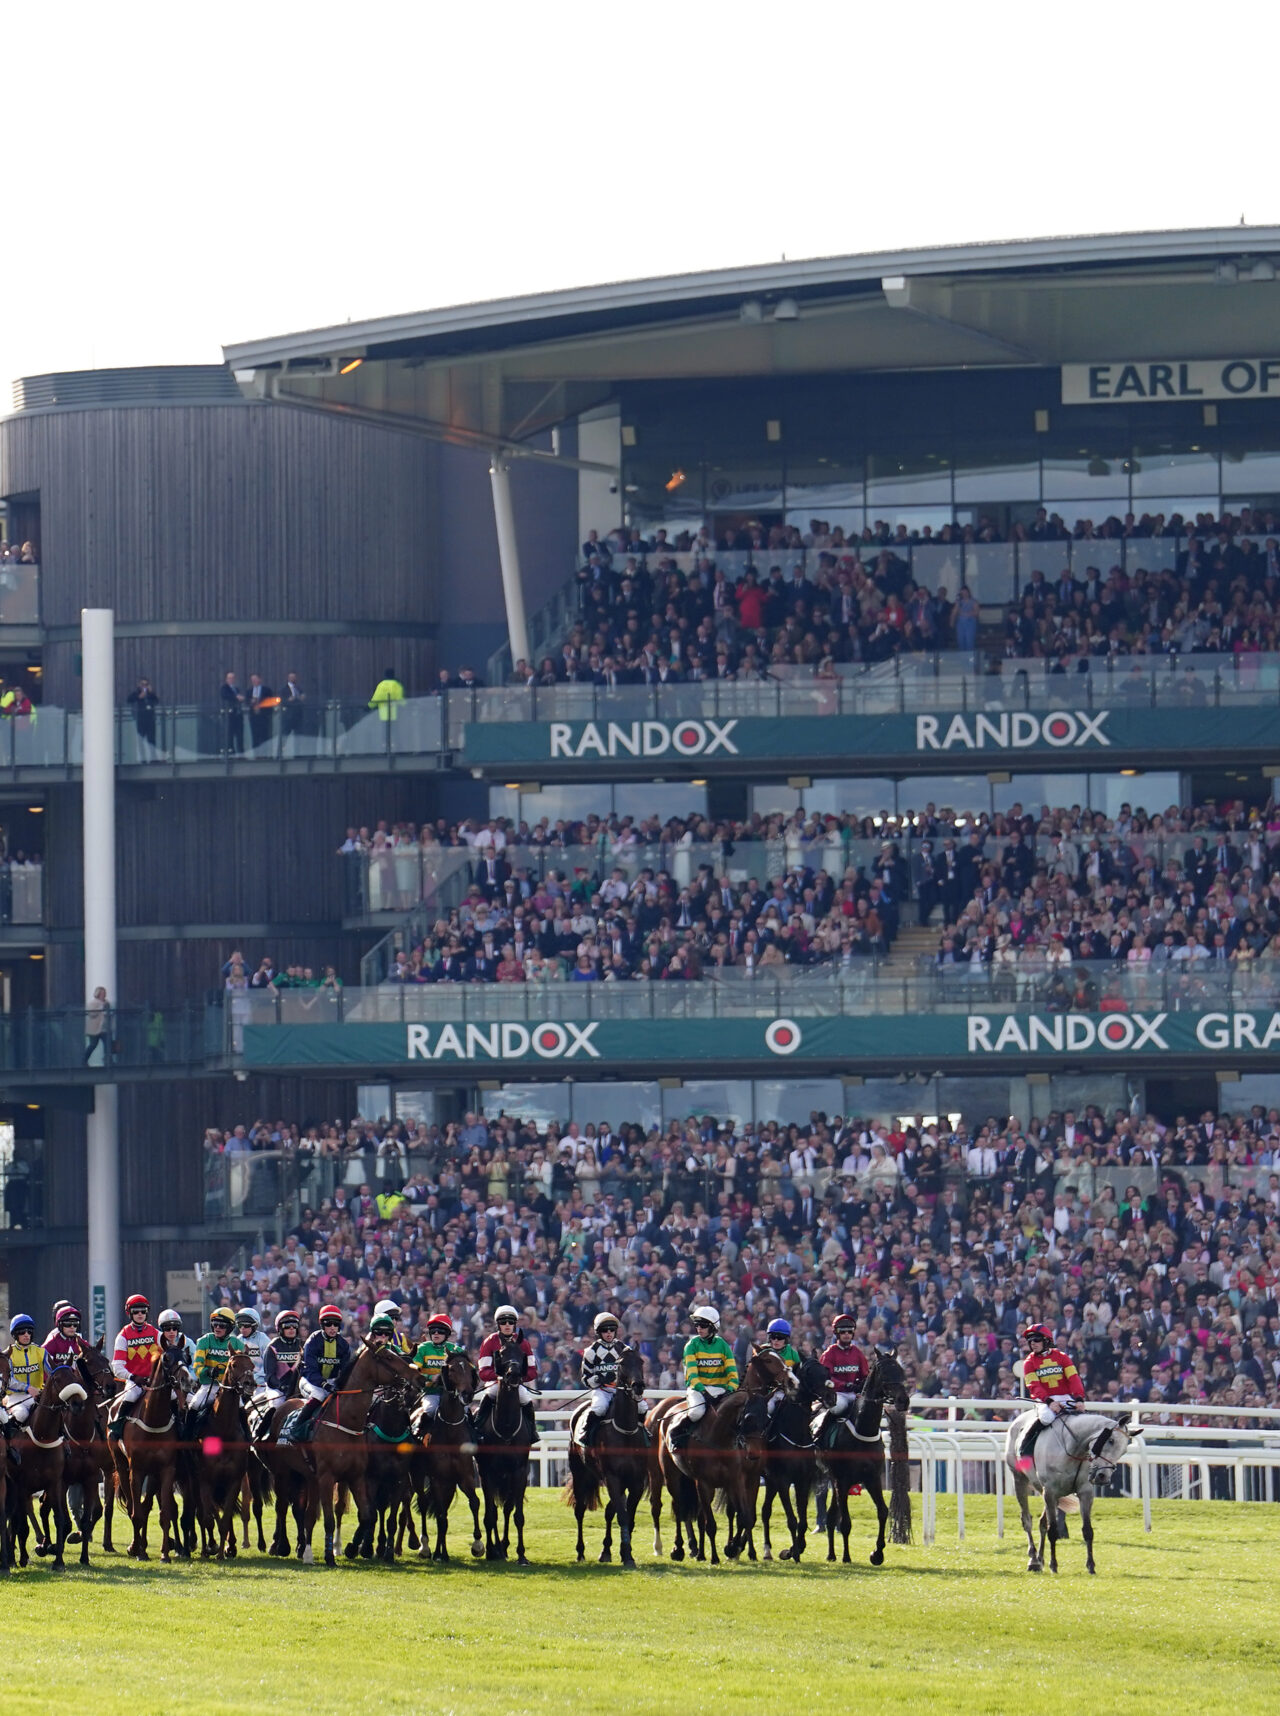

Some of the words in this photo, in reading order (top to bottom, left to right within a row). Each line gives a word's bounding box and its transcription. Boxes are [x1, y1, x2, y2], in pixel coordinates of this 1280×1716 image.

[1088, 365, 1203, 398] EARL
[1221, 361, 1280, 394] OF
[549, 720, 739, 757] RANDOX
[916, 711, 1111, 749] RANDOX
[407, 1021, 600, 1059] RANDOX
[967, 1013, 1169, 1052] RANDOX
[1196, 1011, 1280, 1049] GRA
[94, 1294, 104, 1341] ALTH
[128, 1337, 154, 1345] RANDOX
[14, 1364, 39, 1373] RANDOX
